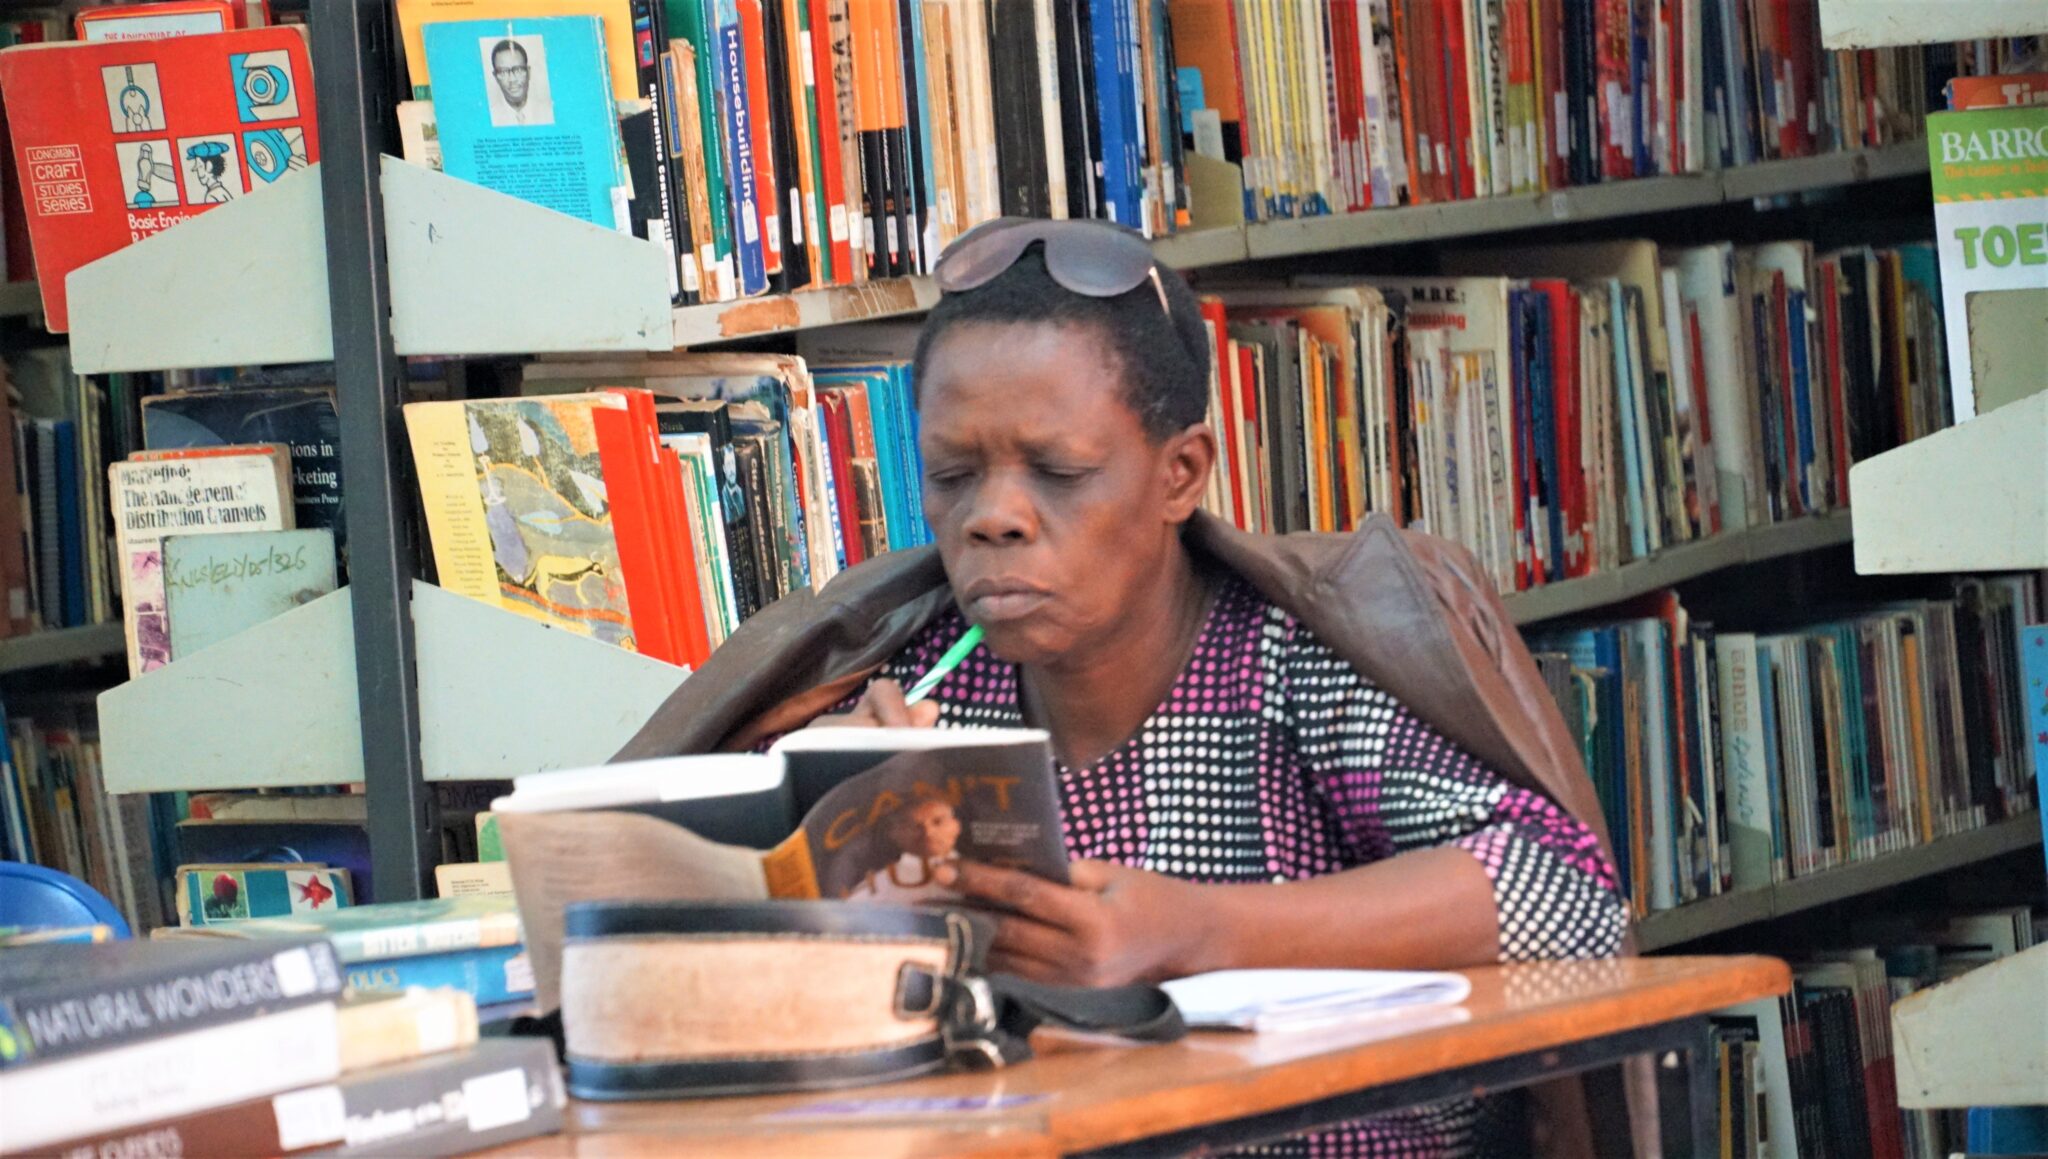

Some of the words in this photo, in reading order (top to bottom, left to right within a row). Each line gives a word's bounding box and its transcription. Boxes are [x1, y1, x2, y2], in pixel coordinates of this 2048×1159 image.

[1489, 25, 1504, 146] BONNER
[649, 83, 663, 161] Alternative
[882, 128, 891, 191] HANDBOOK
[128, 213, 158, 230] Basic
[1954, 223, 2048, 269] TOE
[291, 439, 318, 458] ions
[320, 438, 334, 457] in
[751, 457, 759, 491] City
[125, 489, 147, 508] The
[792, 462, 802, 517] Creative
[821, 441, 833, 481] BOB
[828, 488, 844, 551] DYLAN
[754, 495, 771, 581] Landscape
[26, 989, 149, 1049] NATURAL
[145, 957, 281, 1021] WONDERS
